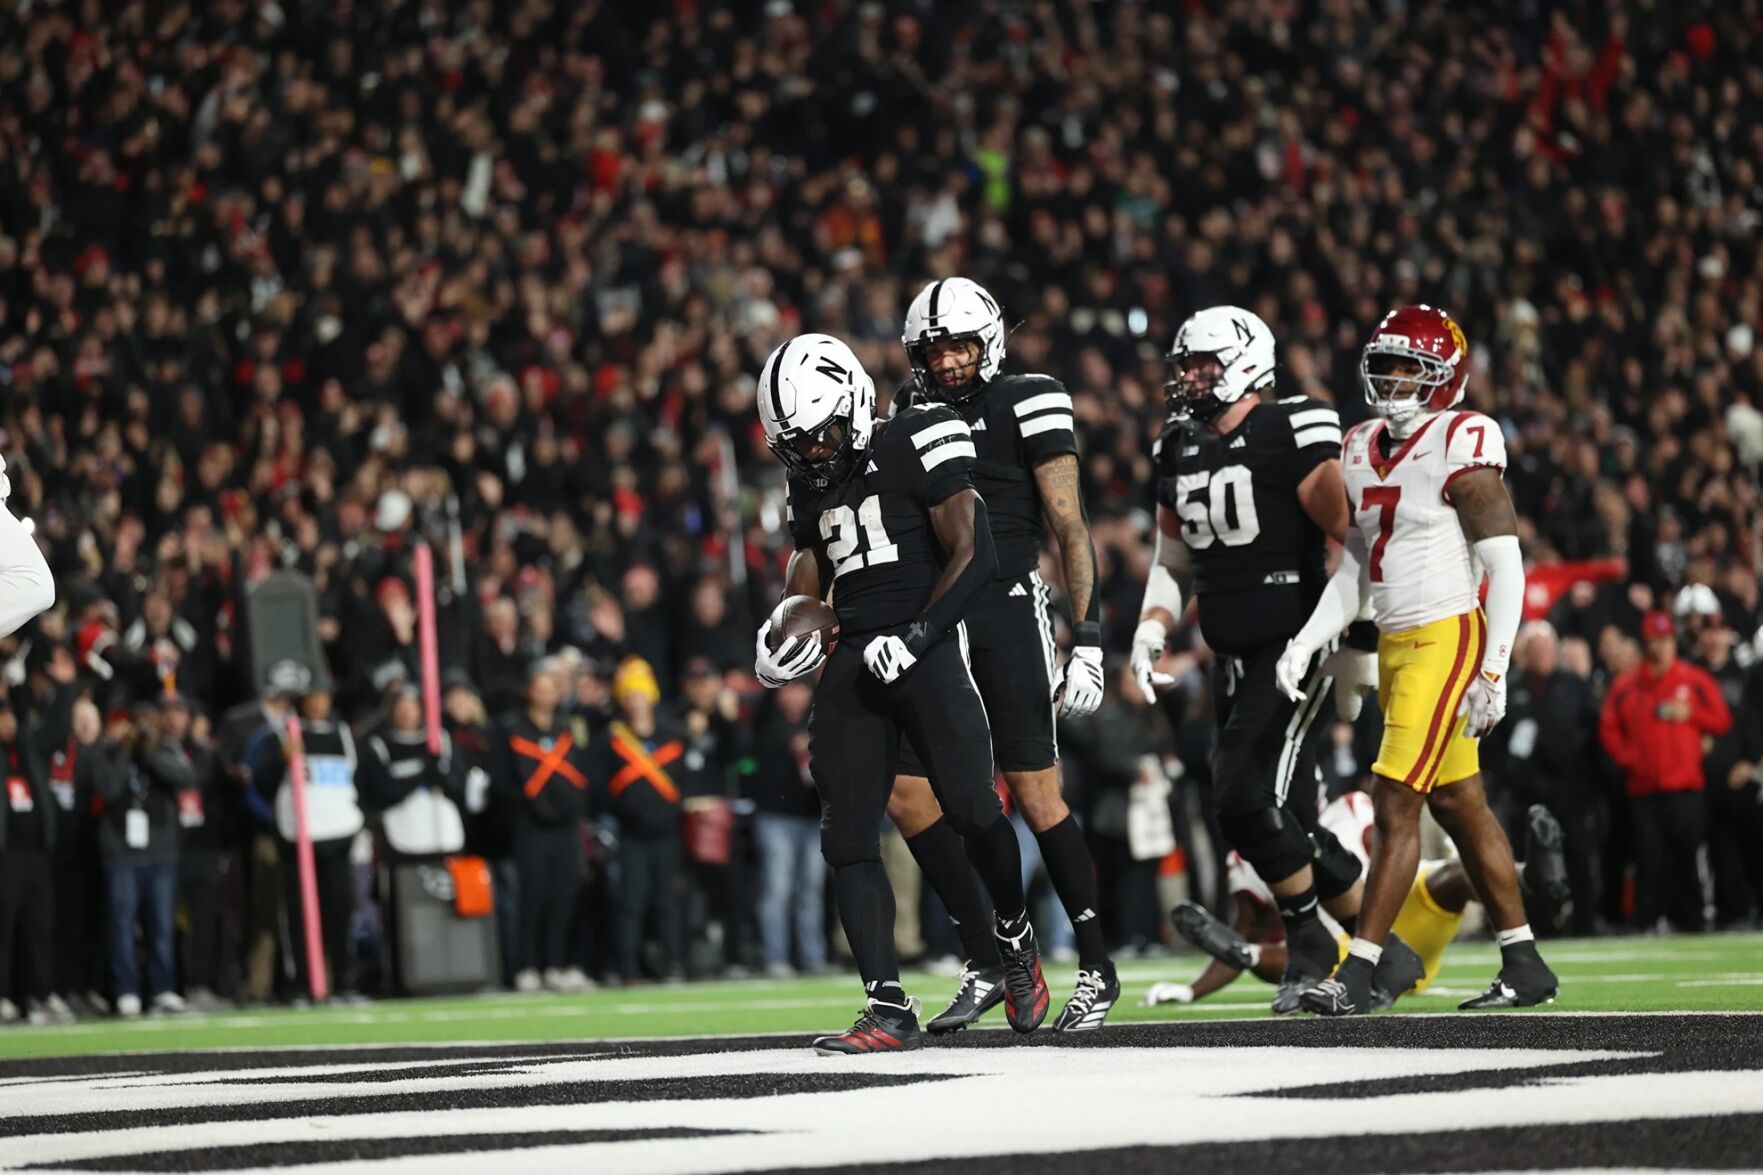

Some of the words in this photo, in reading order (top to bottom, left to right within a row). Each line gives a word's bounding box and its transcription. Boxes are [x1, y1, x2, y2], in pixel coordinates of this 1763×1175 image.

[1231, 318, 1252, 340] N
[815, 355, 848, 384] N
[1466, 425, 1485, 458] 7
[1176, 463, 1260, 549] 50
[1360, 485, 1402, 582] 7
[819, 494, 899, 578] 21
